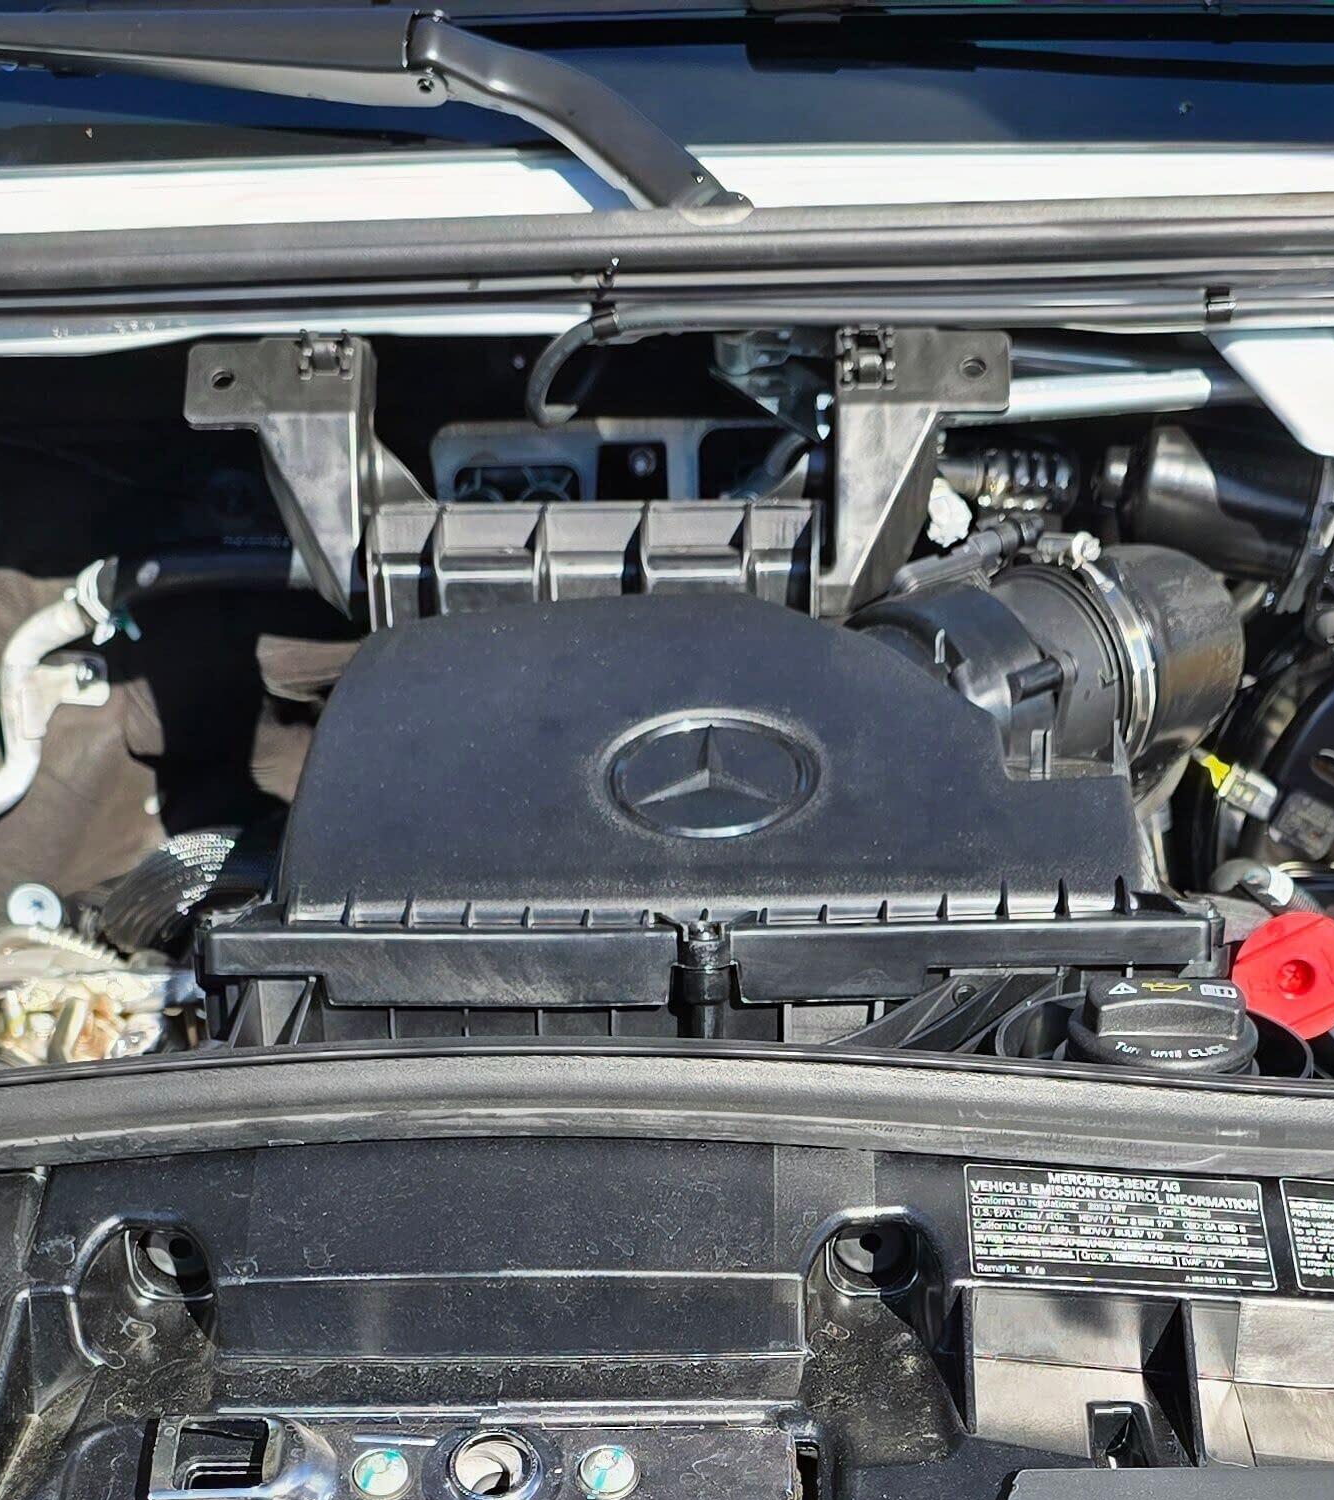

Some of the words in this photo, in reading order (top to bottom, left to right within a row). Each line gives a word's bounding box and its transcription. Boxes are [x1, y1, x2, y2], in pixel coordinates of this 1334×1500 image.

[1151, 1049, 1182, 1059] until
[1188, 1043, 1229, 1058] CLICK
[1047, 1172, 1159, 1189] MERCEDES-BENZ
[1161, 1181, 1180, 1193] AG
[970, 1180, 1028, 1194] VEHICLE
[1031, 1183, 1097, 1198] EMISSION
[1098, 1187, 1163, 1203] CONTROL
[1166, 1193, 1259, 1211] INFORMATION
[971, 1195, 1016, 1206] Conforms
[1017, 1198, 1026, 1206] to
[1028, 1199, 1080, 1210] regulations:
[994, 1208, 1012, 1218] EPA
[1158, 1207, 1179, 1216] Fuel:
[1181, 1208, 1211, 1219] Diesel
[973, 1221, 1017, 1231] California
[1292, 1219, 1310, 1228] This
[1295, 1235, 1313, 1244] and
[1296, 1244, 1316, 1252] time
[1298, 1252, 1323, 1260] under
[977, 1263, 1019, 1273] Remarks:
[1300, 1267, 1331, 1278] weight
